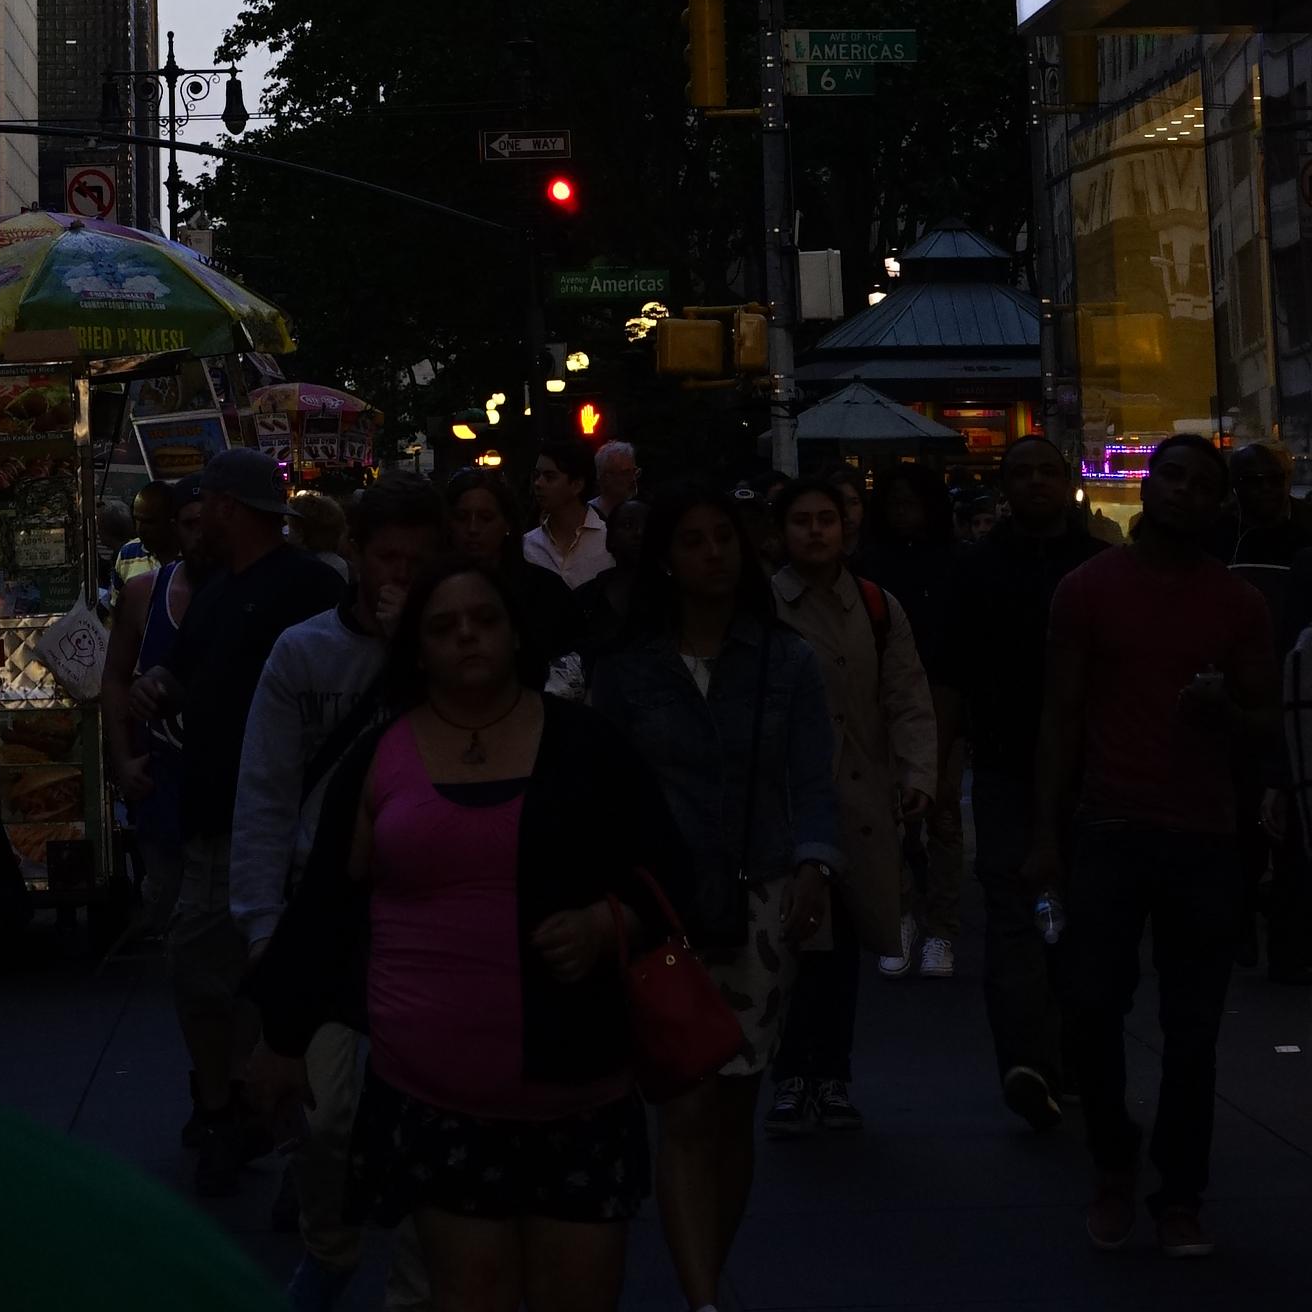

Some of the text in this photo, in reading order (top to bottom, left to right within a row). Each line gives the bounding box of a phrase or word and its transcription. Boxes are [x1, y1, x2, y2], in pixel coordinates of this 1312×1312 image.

[829, 32, 884, 41] AVE OF THE
[810, 43, 905, 60] AMERICAS
[820, 68, 863, 91] 6 AV
[498, 138, 558, 151] ONE WAY
[560, 275, 589, 284] Avenue
[589, 274, 665, 293] Americas
[560, 284, 584, 293] of the
